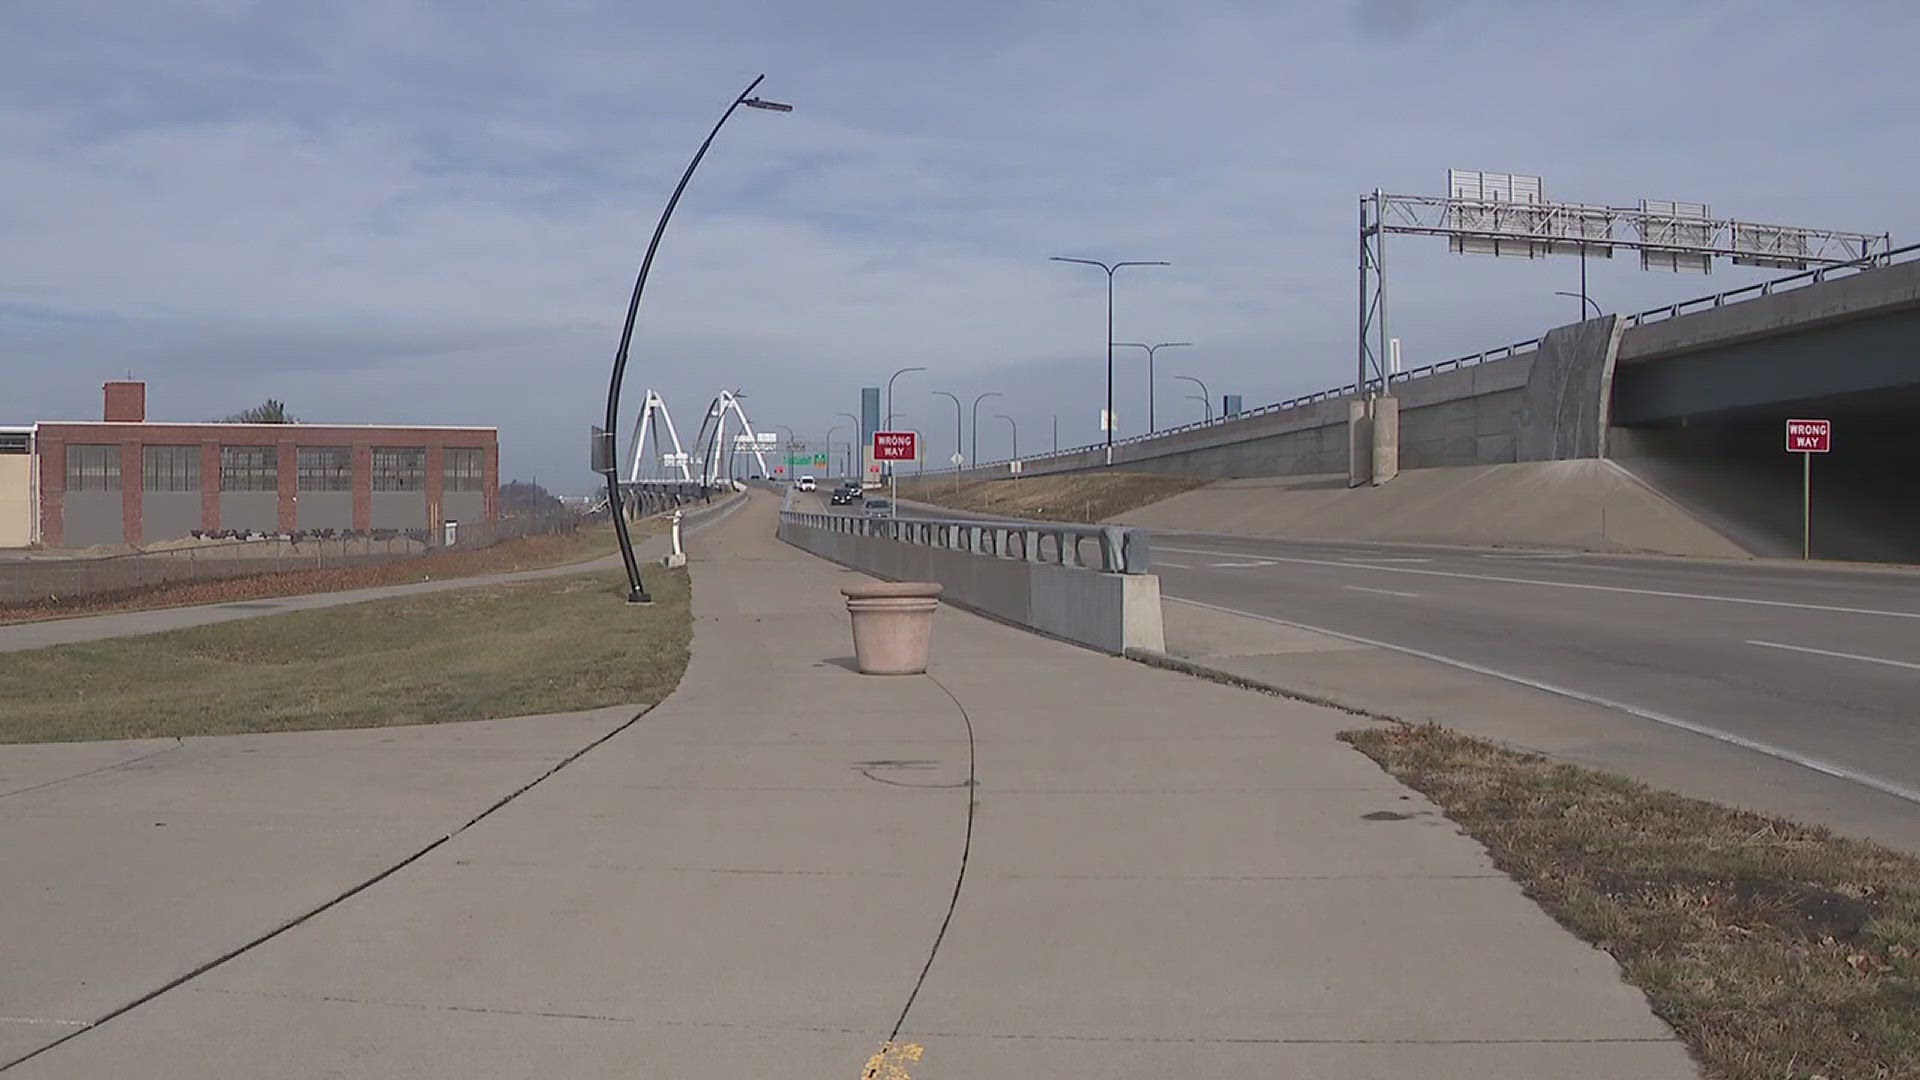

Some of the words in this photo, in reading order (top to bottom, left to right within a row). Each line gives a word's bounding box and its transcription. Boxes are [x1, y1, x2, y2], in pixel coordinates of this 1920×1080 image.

[1789, 424, 1827, 436] WRONG
[877, 435, 912, 446] WRONG
[1796, 436, 1820, 448] WAY
[883, 447, 905, 456] WAY
